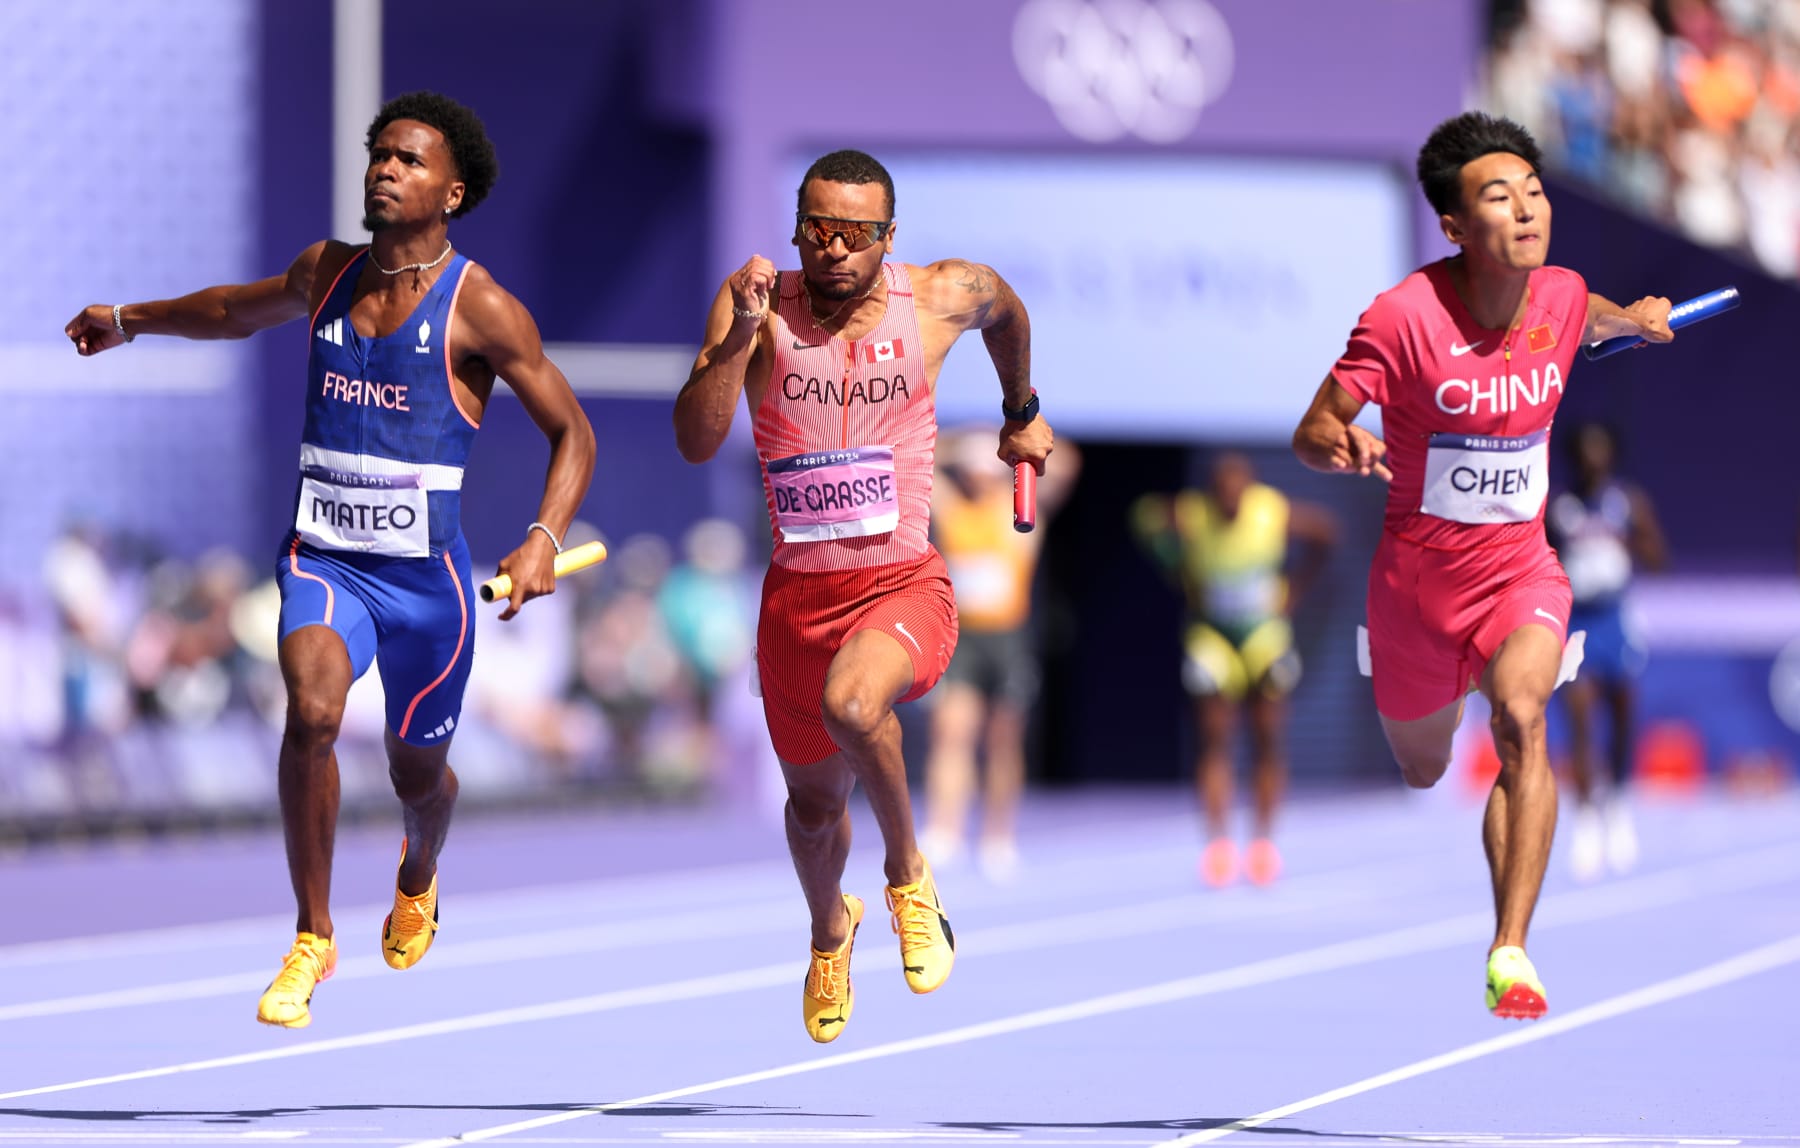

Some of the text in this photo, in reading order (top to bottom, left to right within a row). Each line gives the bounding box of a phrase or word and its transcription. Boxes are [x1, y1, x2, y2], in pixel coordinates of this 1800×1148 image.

[322, 371, 410, 411] FRANCE
[783, 373, 910, 406] CANADA
[1435, 362, 1563, 415] CHINA
[796, 452, 859, 467] PARIS 2024
[1465, 438, 1499, 449] PARIS
[330, 471, 391, 486] PARIS 2024
[775, 475, 893, 513] DE GRASSE
[1451, 464, 1531, 495] CHEN
[312, 497, 416, 531] MATEO
